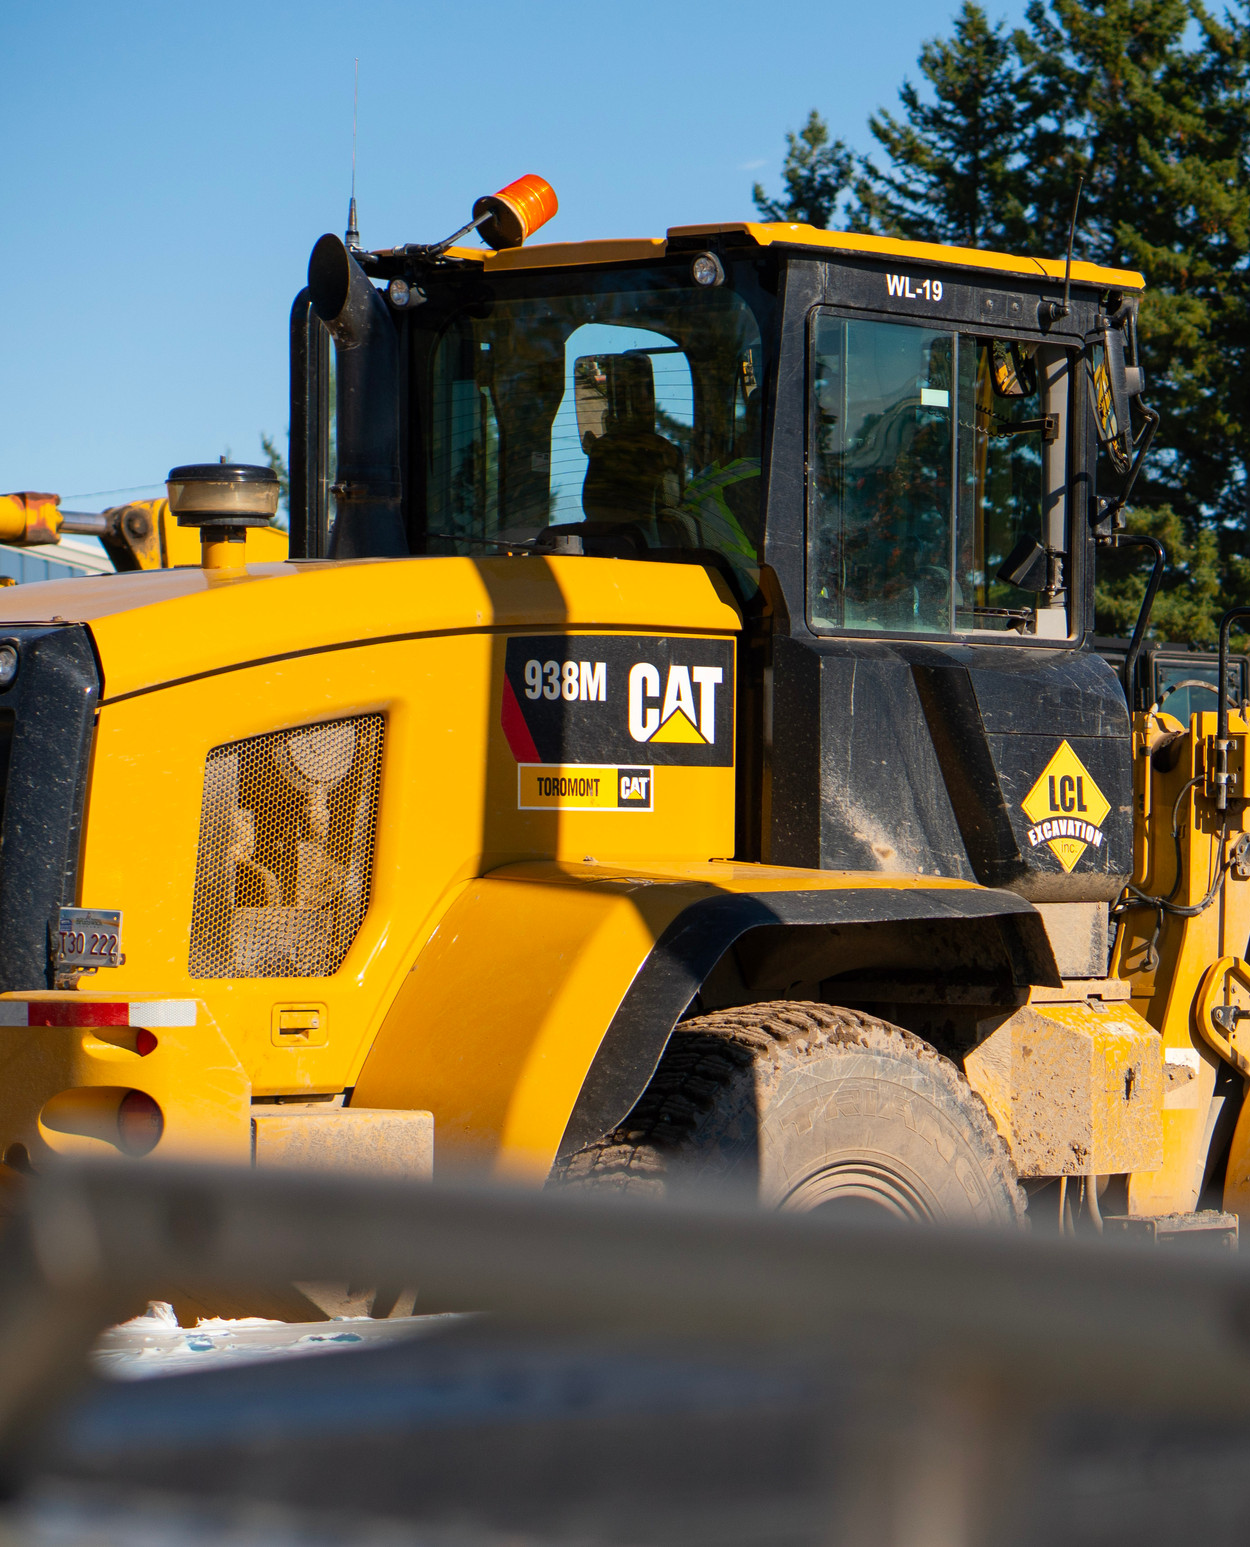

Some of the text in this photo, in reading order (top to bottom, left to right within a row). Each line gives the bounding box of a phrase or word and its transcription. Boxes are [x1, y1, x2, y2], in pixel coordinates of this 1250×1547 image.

[886, 273, 943, 301] WL-19
[524, 659, 723, 744] 938M CAT
[537, 776, 650, 800] TOROMONT CAT
[1048, 775, 1088, 813] LCL
[1027, 819, 1104, 847] EXCAVATION
[1060, 841, 1078, 854] inc.
[60, 931, 118, 956] T30 222
